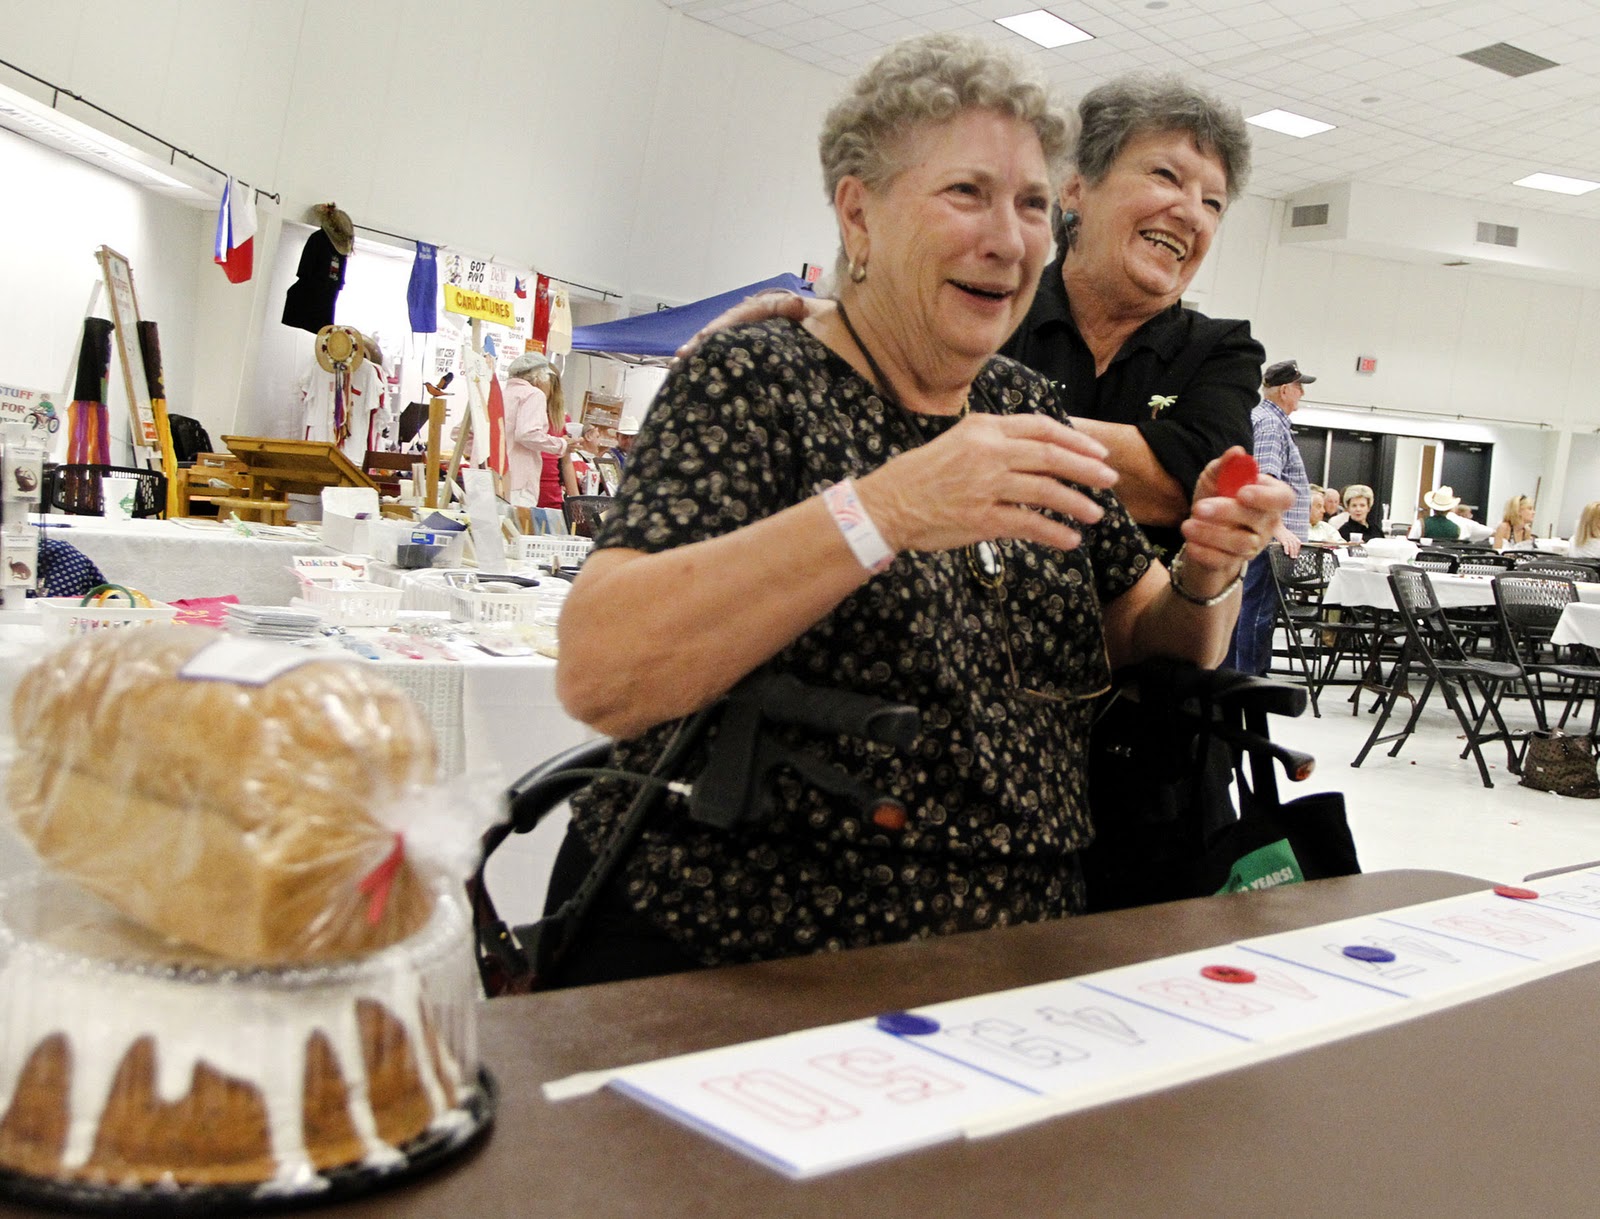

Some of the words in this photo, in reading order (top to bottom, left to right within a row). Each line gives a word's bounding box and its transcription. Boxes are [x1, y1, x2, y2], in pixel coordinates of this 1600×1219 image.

[470, 261, 486, 273] GOT
[467, 272, 484, 283] PIVO
[455, 291, 510, 319] CARICATURES
[1, 402, 26, 414] FOR
[1250, 867, 1294, 890] YEARS!
[699, 1046, 967, 1131] 50
